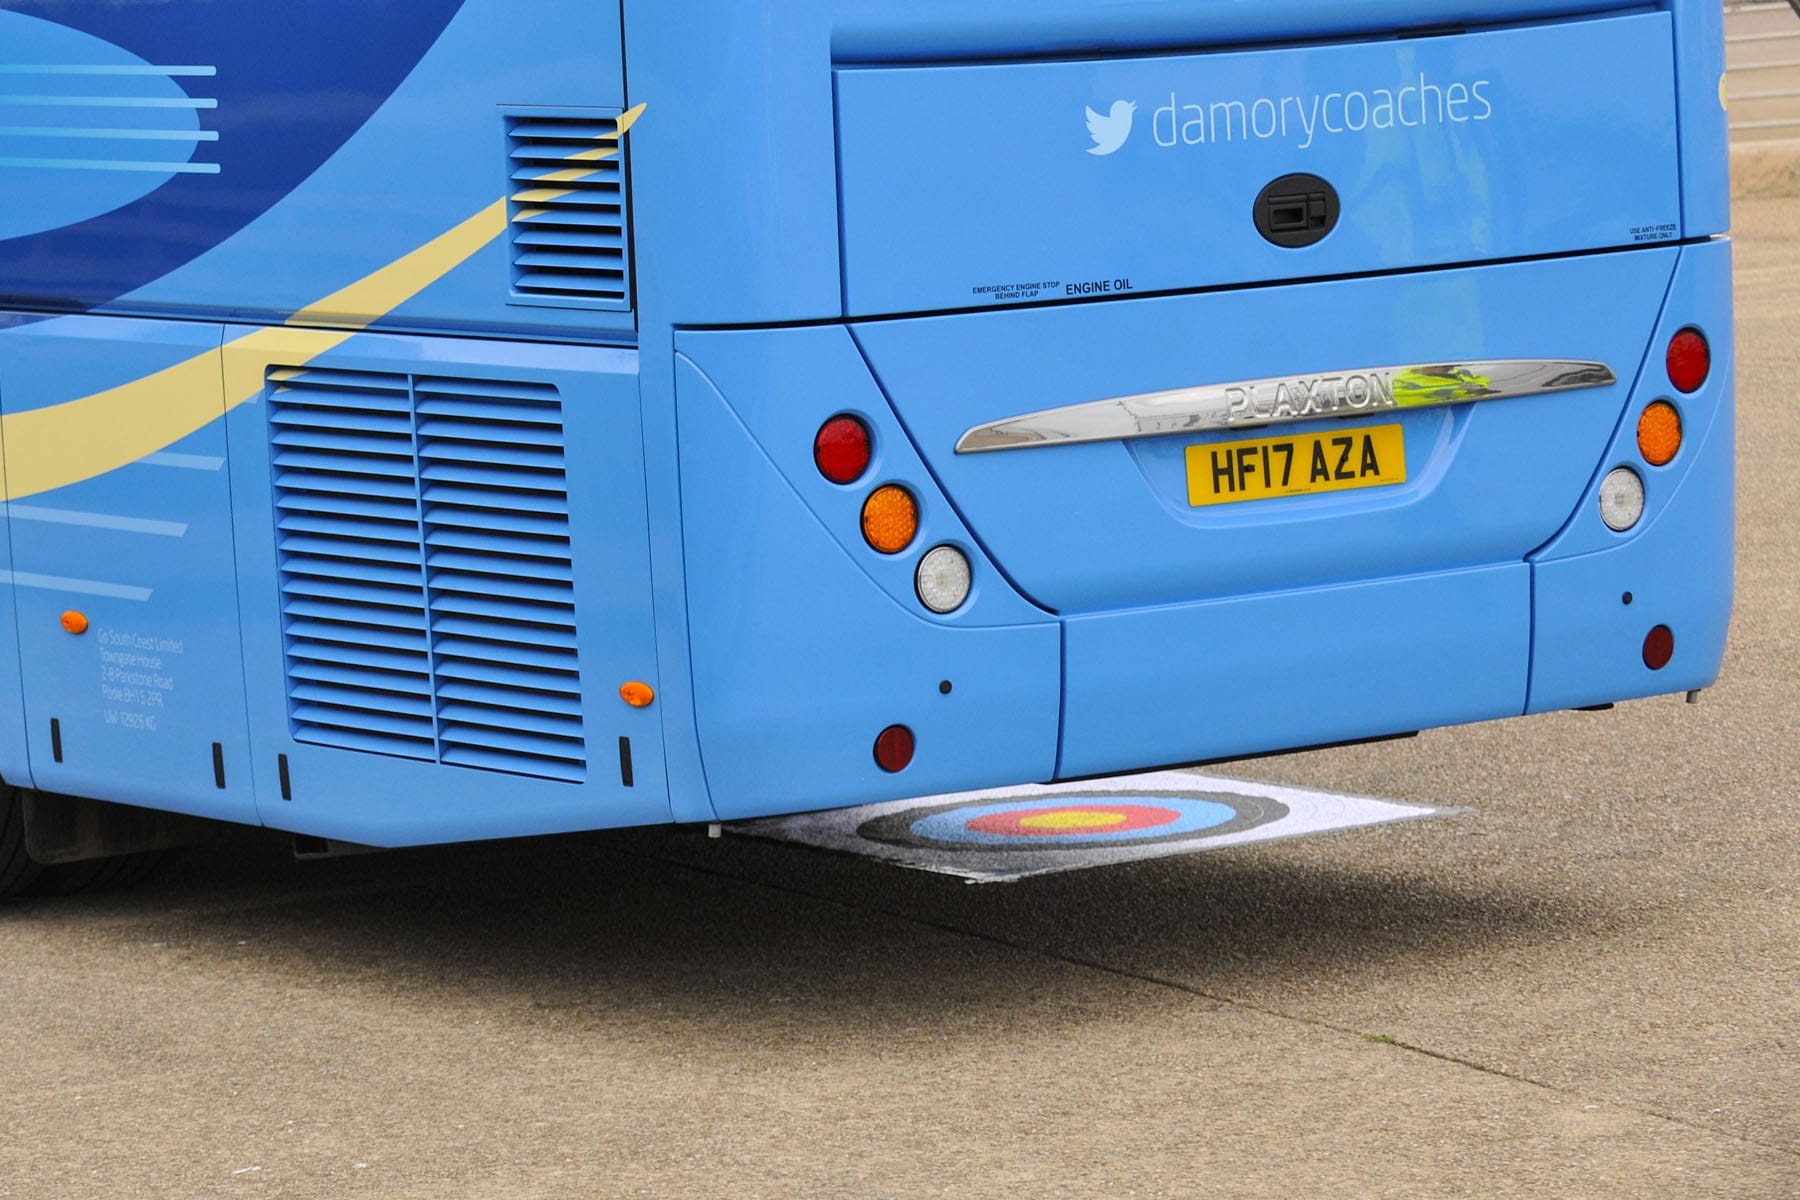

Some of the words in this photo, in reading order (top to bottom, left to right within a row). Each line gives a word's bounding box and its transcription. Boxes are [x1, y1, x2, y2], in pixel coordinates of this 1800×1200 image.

[1152, 71, 1492, 149] damorycoaches
[972, 285, 1015, 295] EMERGENCY
[1016, 283, 1041, 291] ENGINE
[1042, 281, 1060, 289] STOP
[995, 291, 1020, 300] BEHIND
[1021, 290, 1039, 298] FLAP
[1066, 280, 1110, 295] ENGINE
[1113, 278, 1133, 290] OIL
[1225, 372, 1394, 422] PLAXTON
[1211, 443, 1294, 494] HF17
[1310, 434, 1380, 483] AZA
[153, 672, 173, 690] Road
